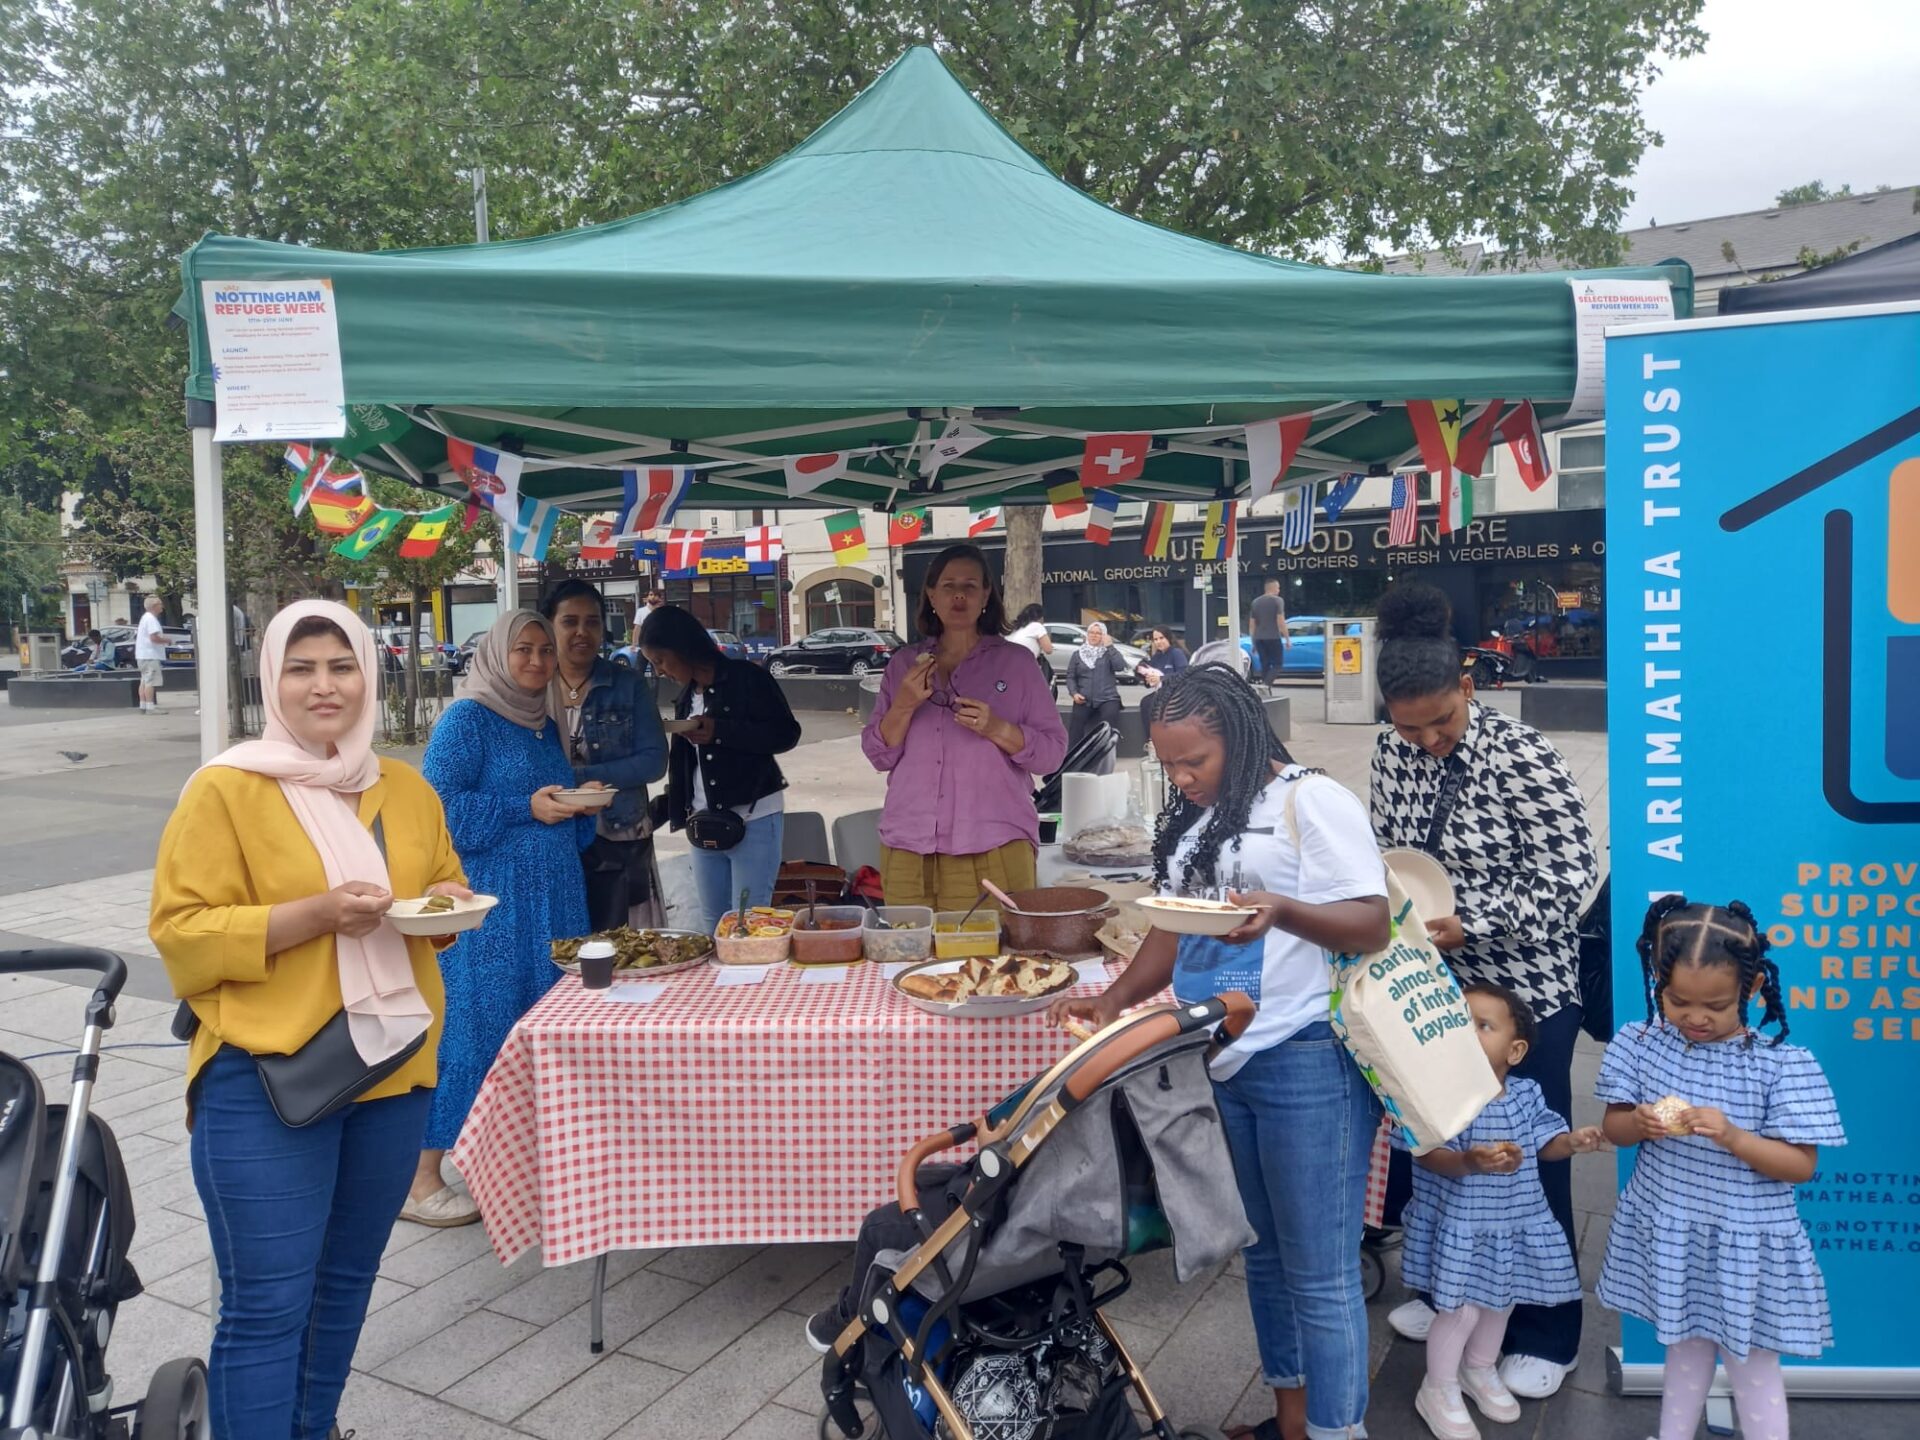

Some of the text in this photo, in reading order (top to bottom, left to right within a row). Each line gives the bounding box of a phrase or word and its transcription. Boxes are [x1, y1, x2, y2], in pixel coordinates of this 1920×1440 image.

[215, 290, 321, 303] NOTTINGHAM
[215, 302, 326, 315] REFUGEE WEEK
[1578, 295, 1670, 303] SELECTED HIGHLIGHTS
[1643, 353, 1681, 526] TRUST
[1373, 518, 1508, 550] CNRE
[1104, 565, 1171, 580] GROCERY
[1277, 555, 1359, 572] BUTCHERS
[1387, 550, 1440, 566] FRESH
[1449, 543, 1560, 562] VEGETABLES
[1644, 550, 1683, 862] ARIMATHEA
[1798, 863, 1918, 887] PROV
[1766, 924, 1920, 948] OUSIN
[1757, 985, 1920, 1010] ND AS
[1403, 997, 1421, 1024] of
